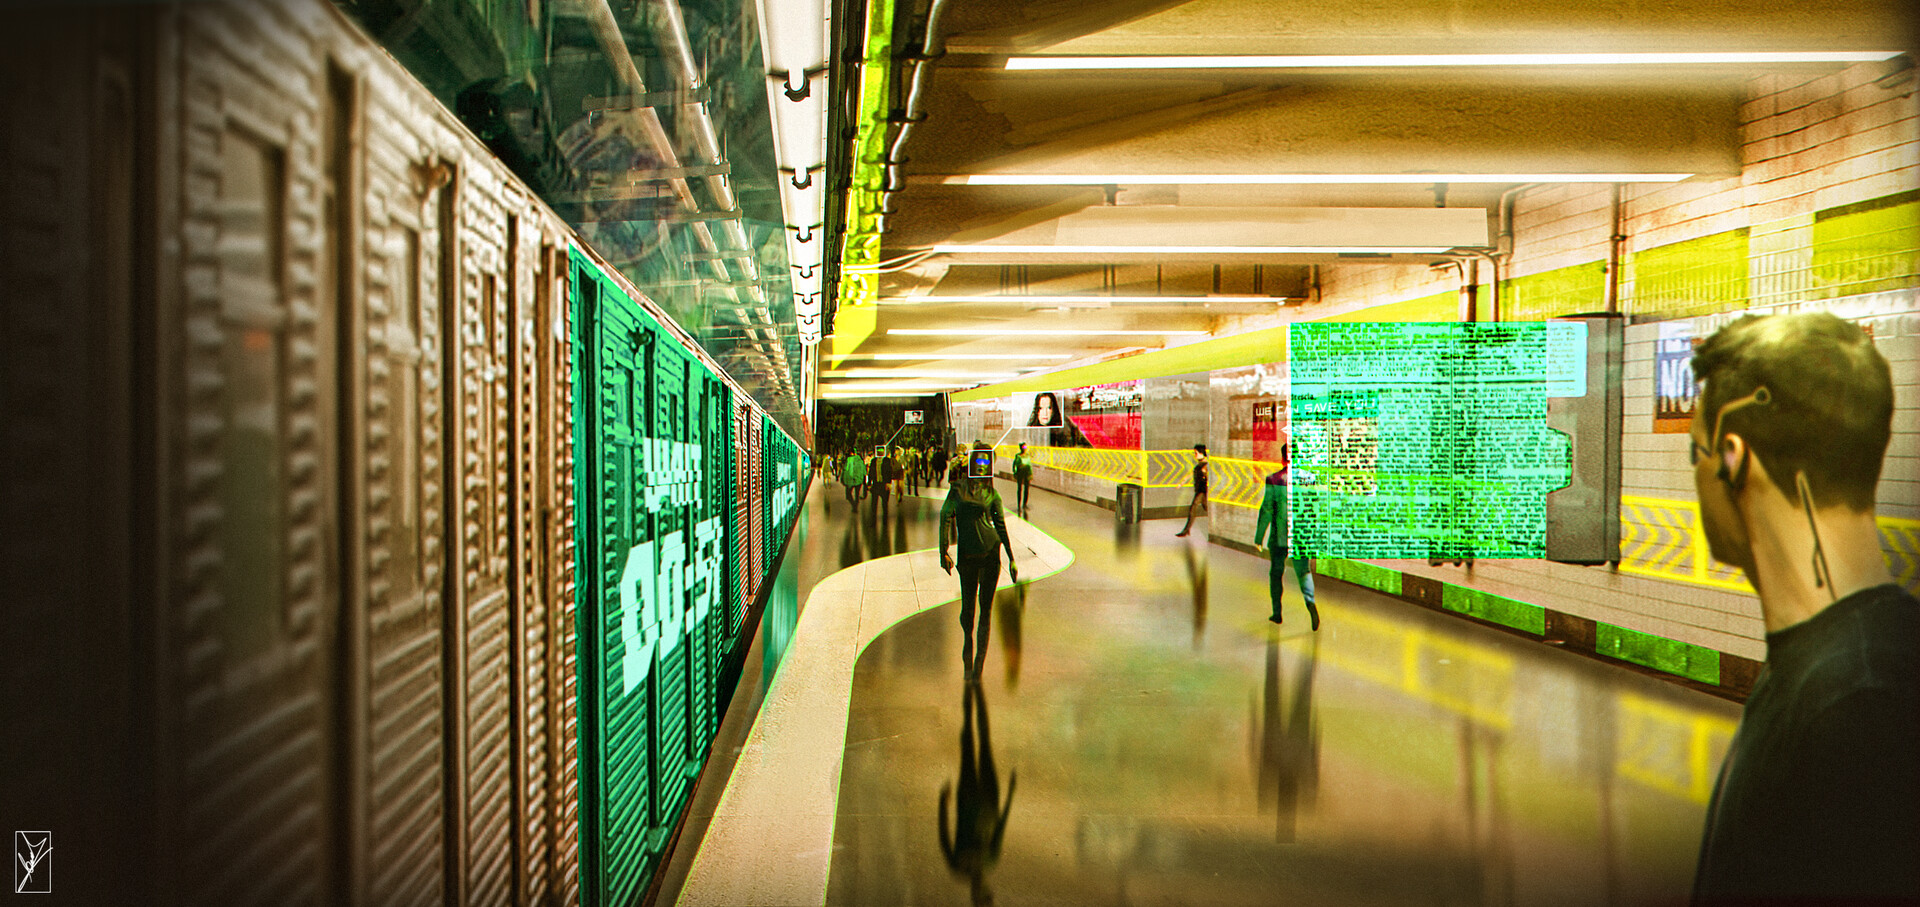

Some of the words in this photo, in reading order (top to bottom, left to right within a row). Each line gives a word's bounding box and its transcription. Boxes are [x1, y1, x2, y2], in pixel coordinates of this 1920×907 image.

[1255, 406, 1272, 417] WE
[1304, 402, 1337, 413] SAVE
[1344, 398, 1376, 410] YOU
